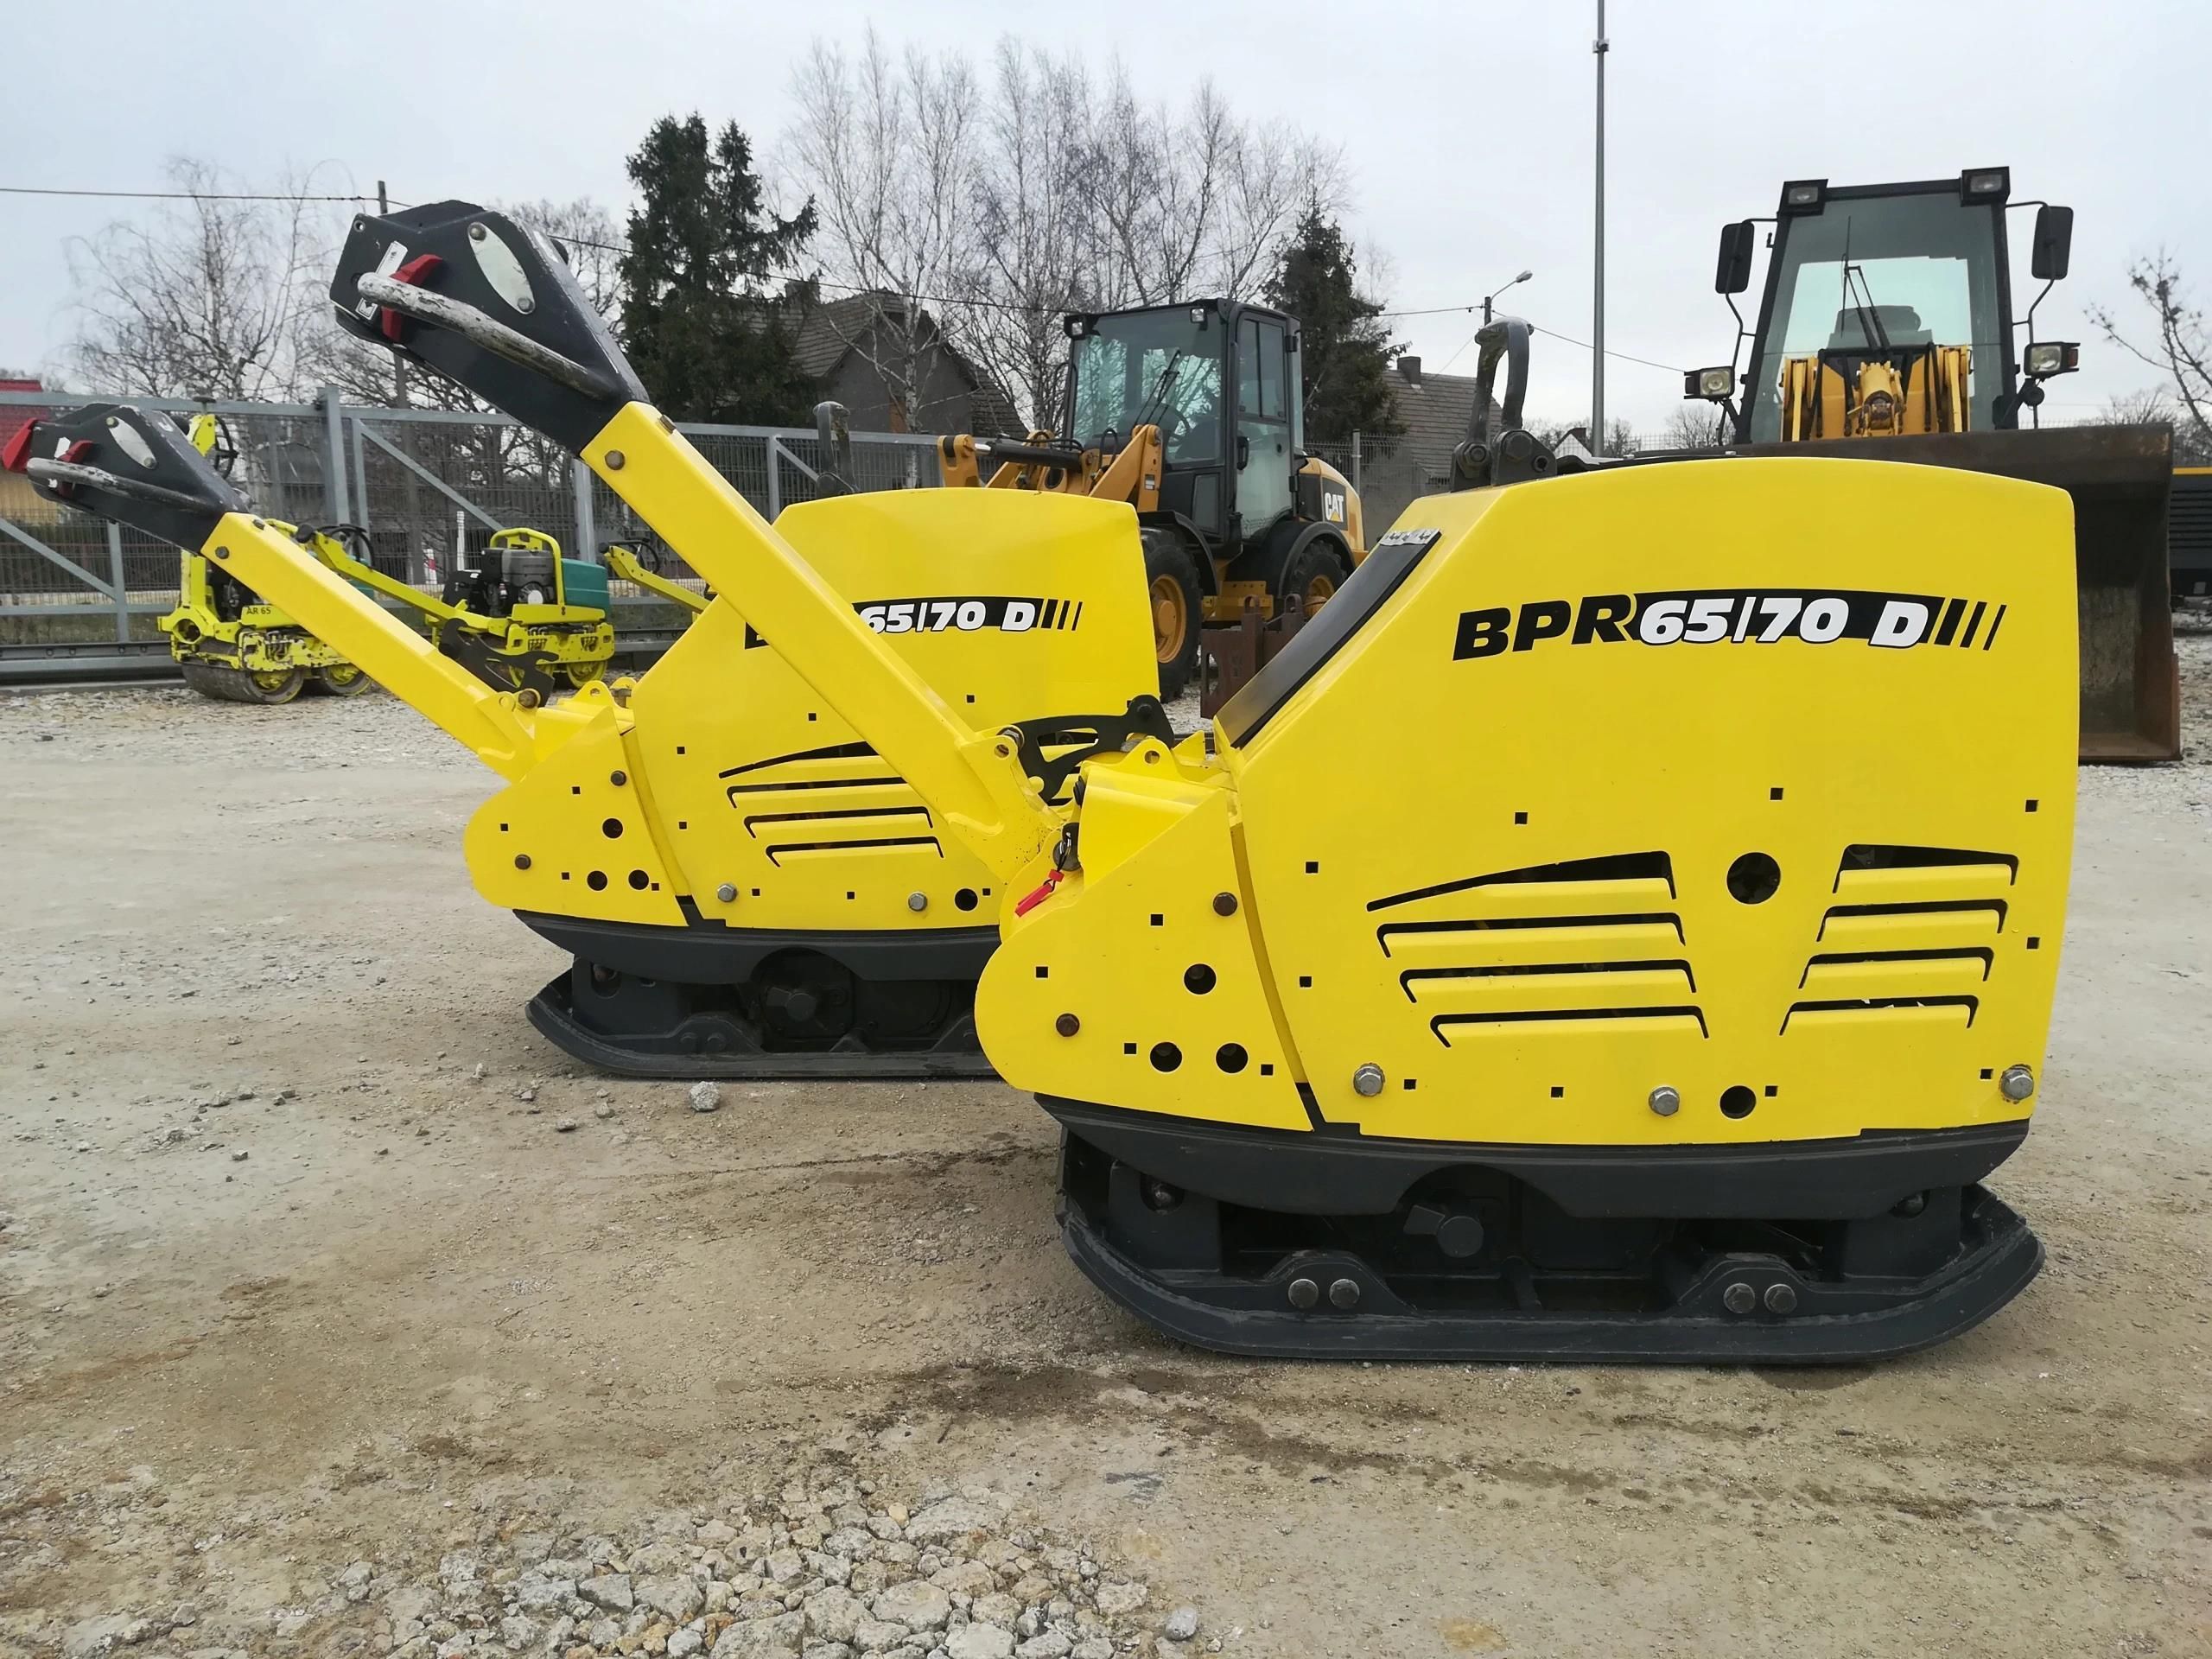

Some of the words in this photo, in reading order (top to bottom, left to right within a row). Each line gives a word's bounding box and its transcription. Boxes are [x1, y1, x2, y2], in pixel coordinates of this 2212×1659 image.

[1325, 493, 1344, 522] CAT
[1001, 601, 1036, 632] D
[1868, 601, 1929, 649] D
